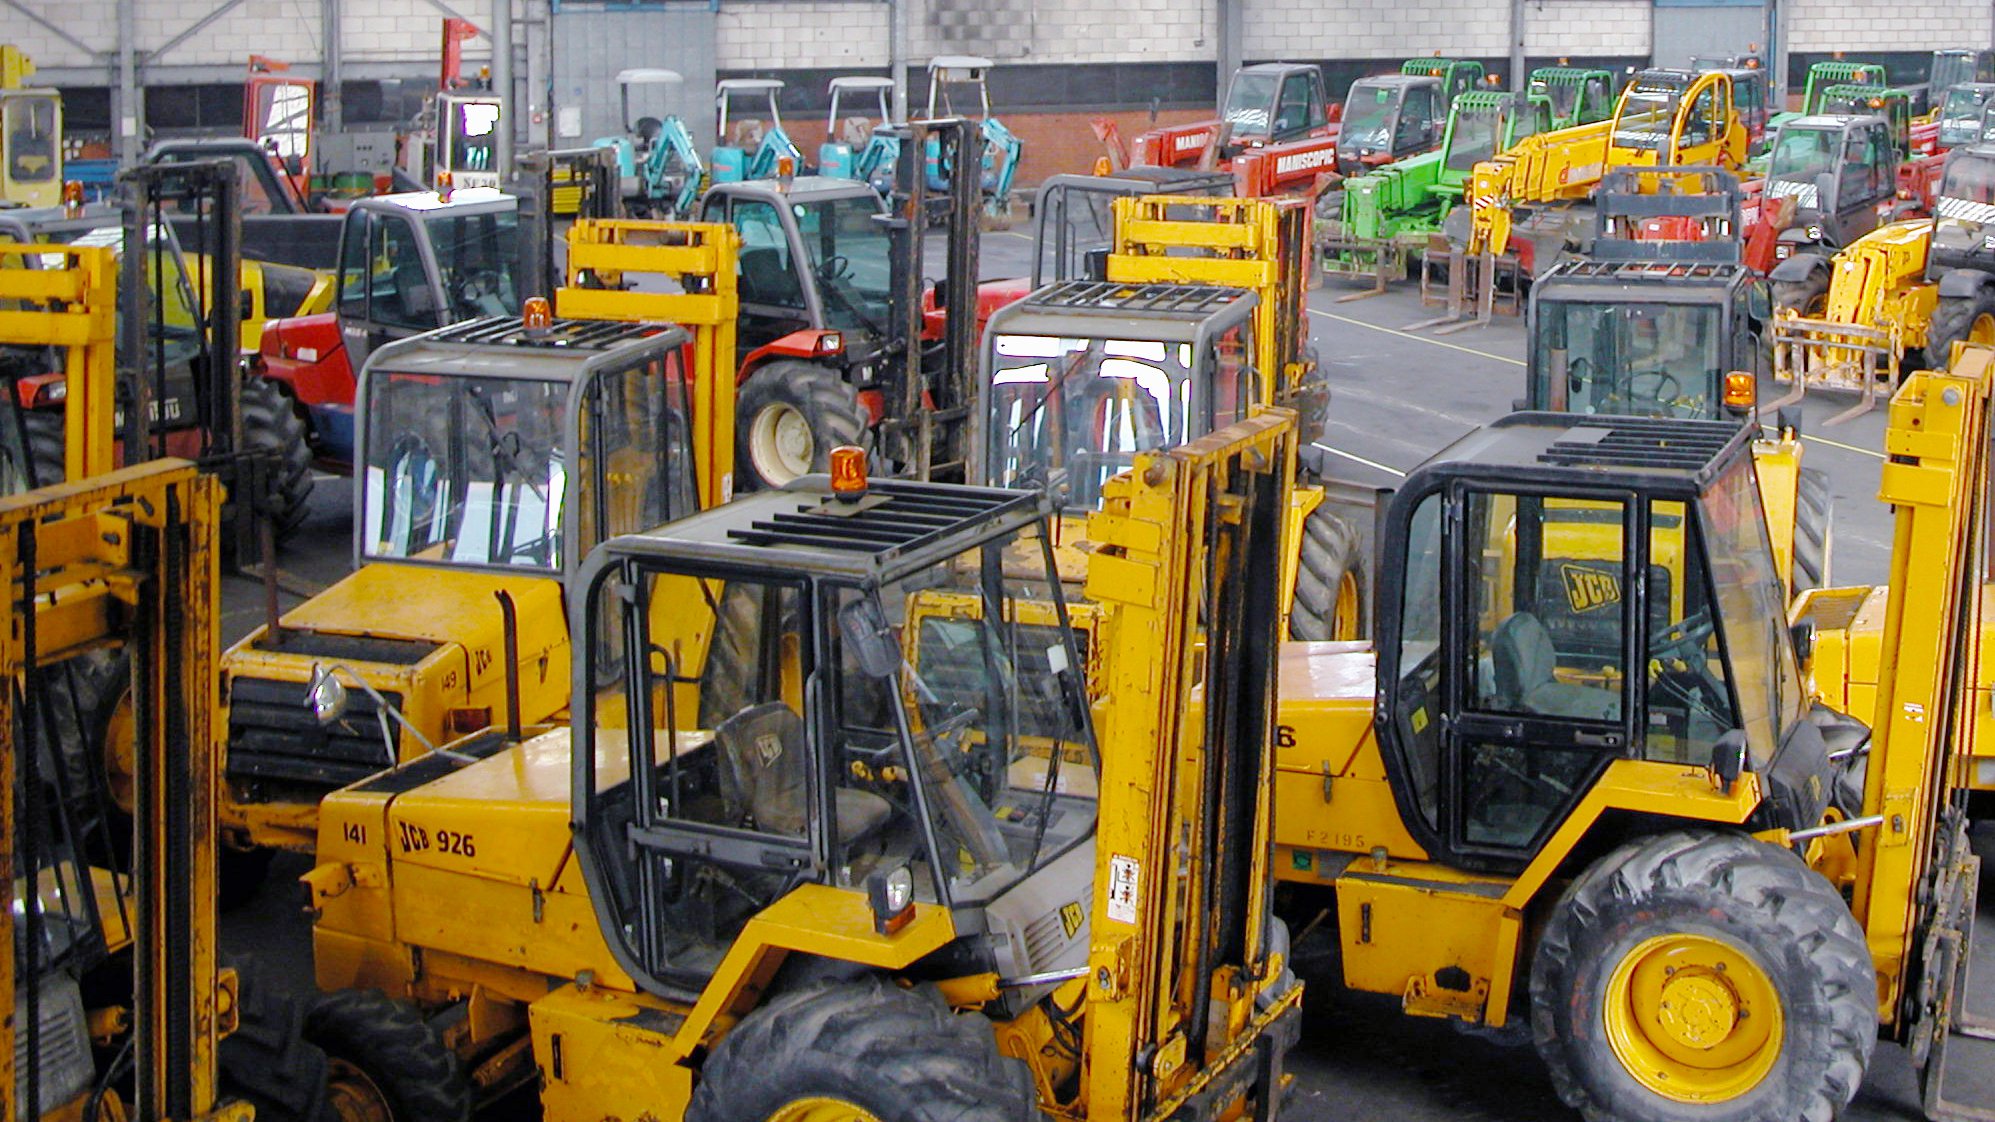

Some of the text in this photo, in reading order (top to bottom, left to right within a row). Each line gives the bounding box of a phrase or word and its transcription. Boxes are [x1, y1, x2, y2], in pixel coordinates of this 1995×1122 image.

[1276, 148, 1335, 174] MANISCOPIC
[1567, 569, 1618, 610] JCB
[343, 820, 476, 858] 141 JCB 926
